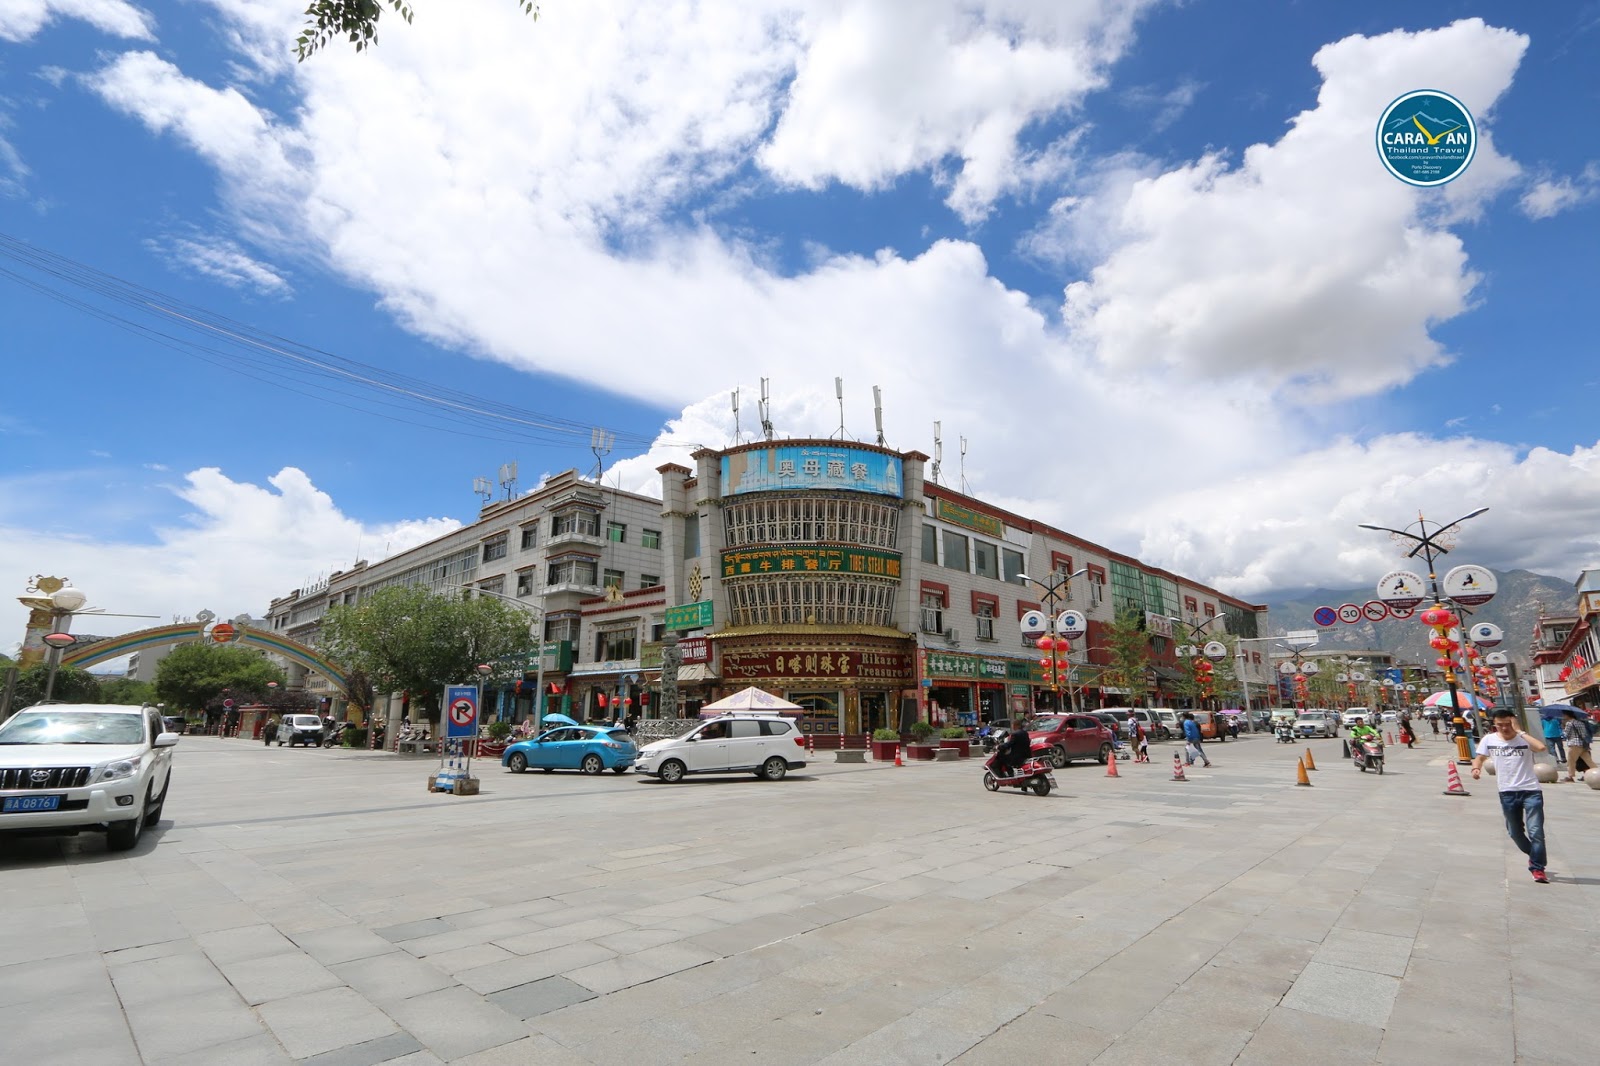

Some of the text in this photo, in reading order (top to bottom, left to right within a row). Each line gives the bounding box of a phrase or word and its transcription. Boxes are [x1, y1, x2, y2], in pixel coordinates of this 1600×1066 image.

[779, 460, 868, 480] 奥母藏餐
[725, 559, 841, 576] 西藏牛排餐厅
[850, 554, 865, 572] TIBET
[868, 556, 884, 574] STEAK
[1343, 610, 1358, 618] 30
[776, 653, 850, 675] 日喀则珠宝
[862, 653, 898, 665] Rikaze
[857, 665, 902, 677] Treasure
